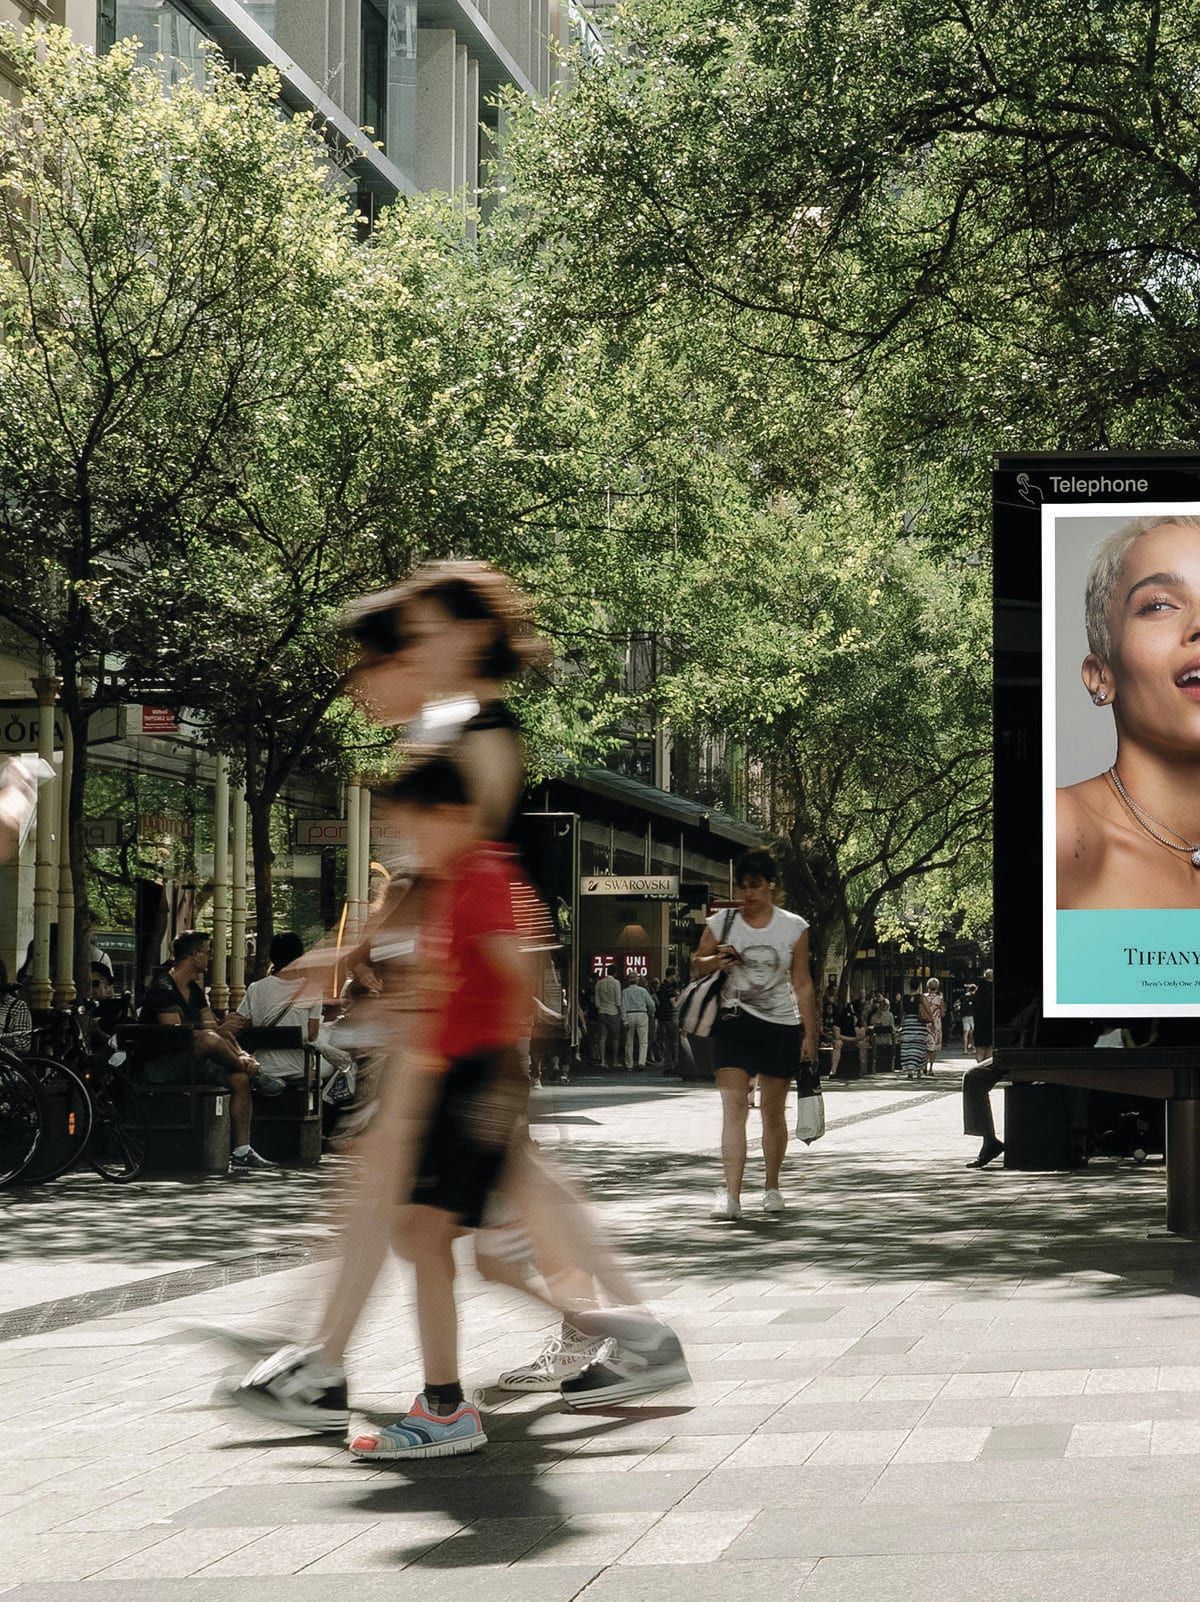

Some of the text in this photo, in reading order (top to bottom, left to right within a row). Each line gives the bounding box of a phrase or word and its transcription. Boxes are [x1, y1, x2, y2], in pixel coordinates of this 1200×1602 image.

[1049, 476, 1149, 495] Telephone
[0, 713, 65, 743] ORA
[604, 880, 670, 890] SWAROVSKI
[626, 956, 646, 966] UNI
